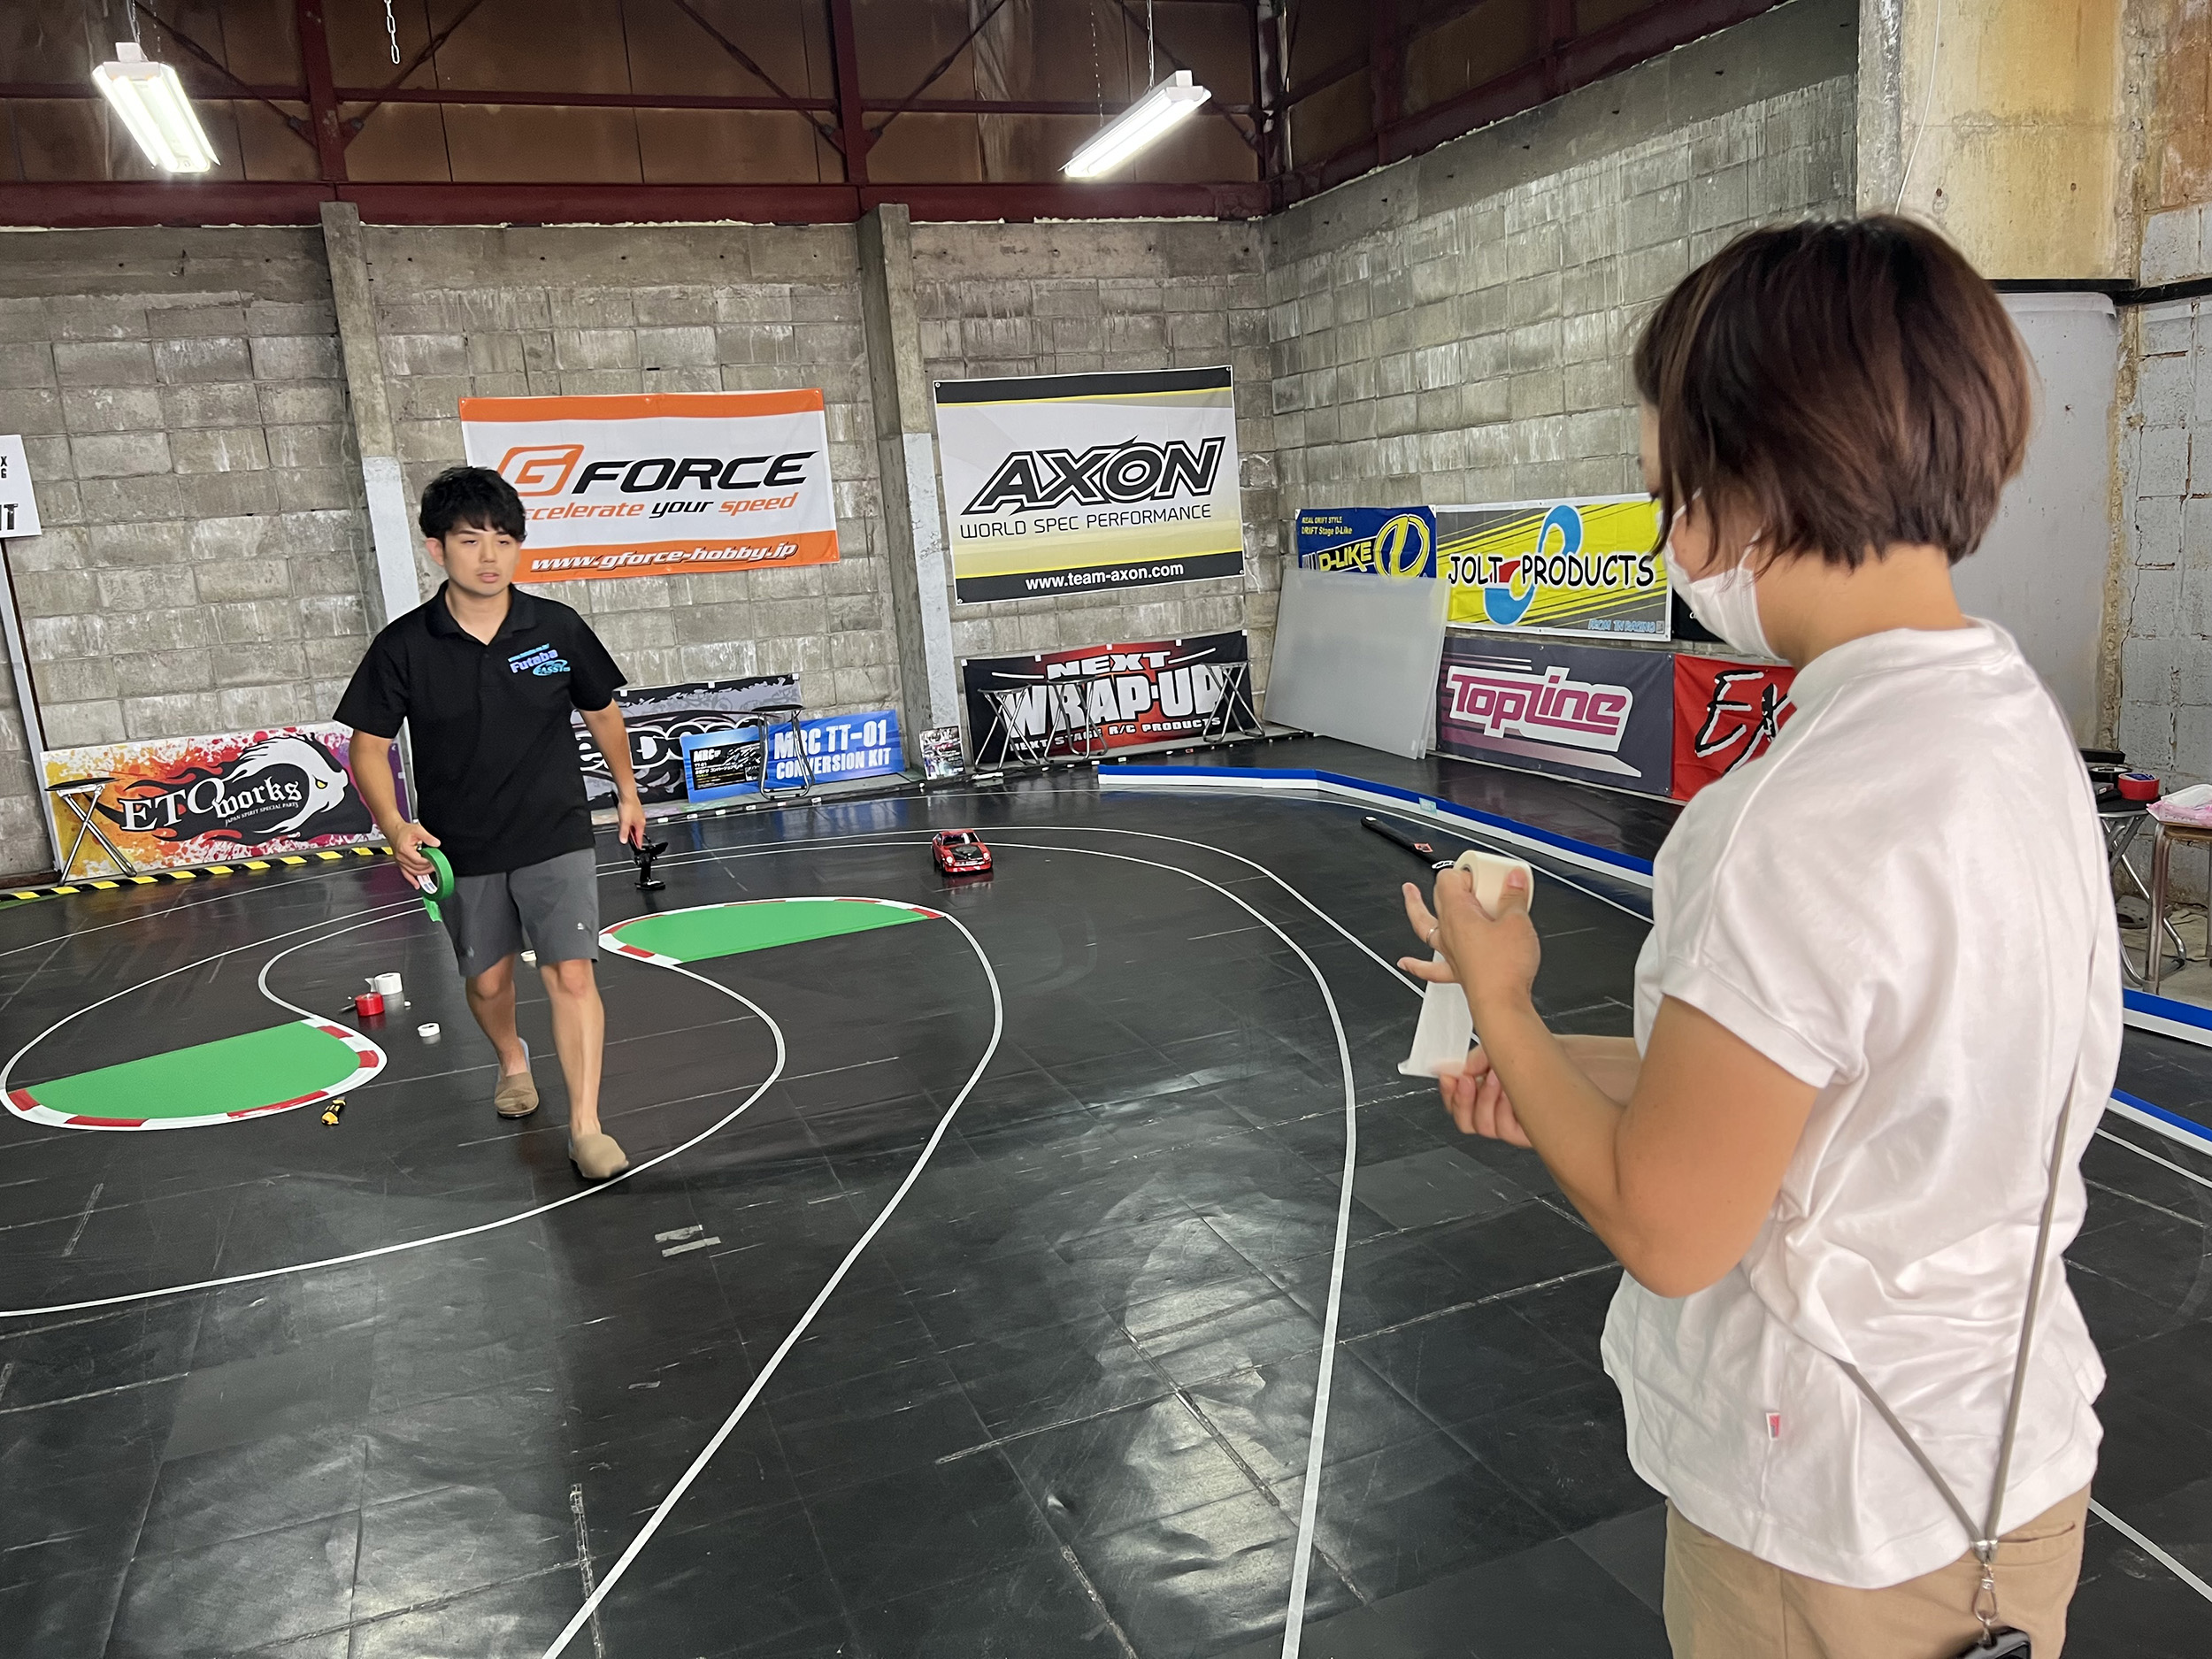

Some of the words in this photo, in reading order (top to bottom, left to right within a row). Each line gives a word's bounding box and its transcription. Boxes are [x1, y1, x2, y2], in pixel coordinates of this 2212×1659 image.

[960, 434, 1226, 516] AXON
[524, 503, 645, 521] ccelerate
[649, 499, 714, 518] your
[718, 492, 799, 517] speed
[960, 520, 1026, 539] WORLD
[1034, 516, 1079, 534] SPEC
[1087, 503, 1211, 529] PERFORMANCE
[530, 541, 798, 573] www.gforce-hobby.jp
[1448, 555, 1503, 585] JOLT
[1520, 554, 1655, 588] PRODUCTS
[1025, 562, 1185, 590] www.team-axon.com
[510, 649, 559, 673] Futaba
[1047, 651, 1171, 679] NEXT
[826, 719, 887, 752] TT-01
[1109, 722, 1135, 735] R/C
[1142, 717, 1221, 733] PRODUCTS
[868, 748, 892, 767] KIT
